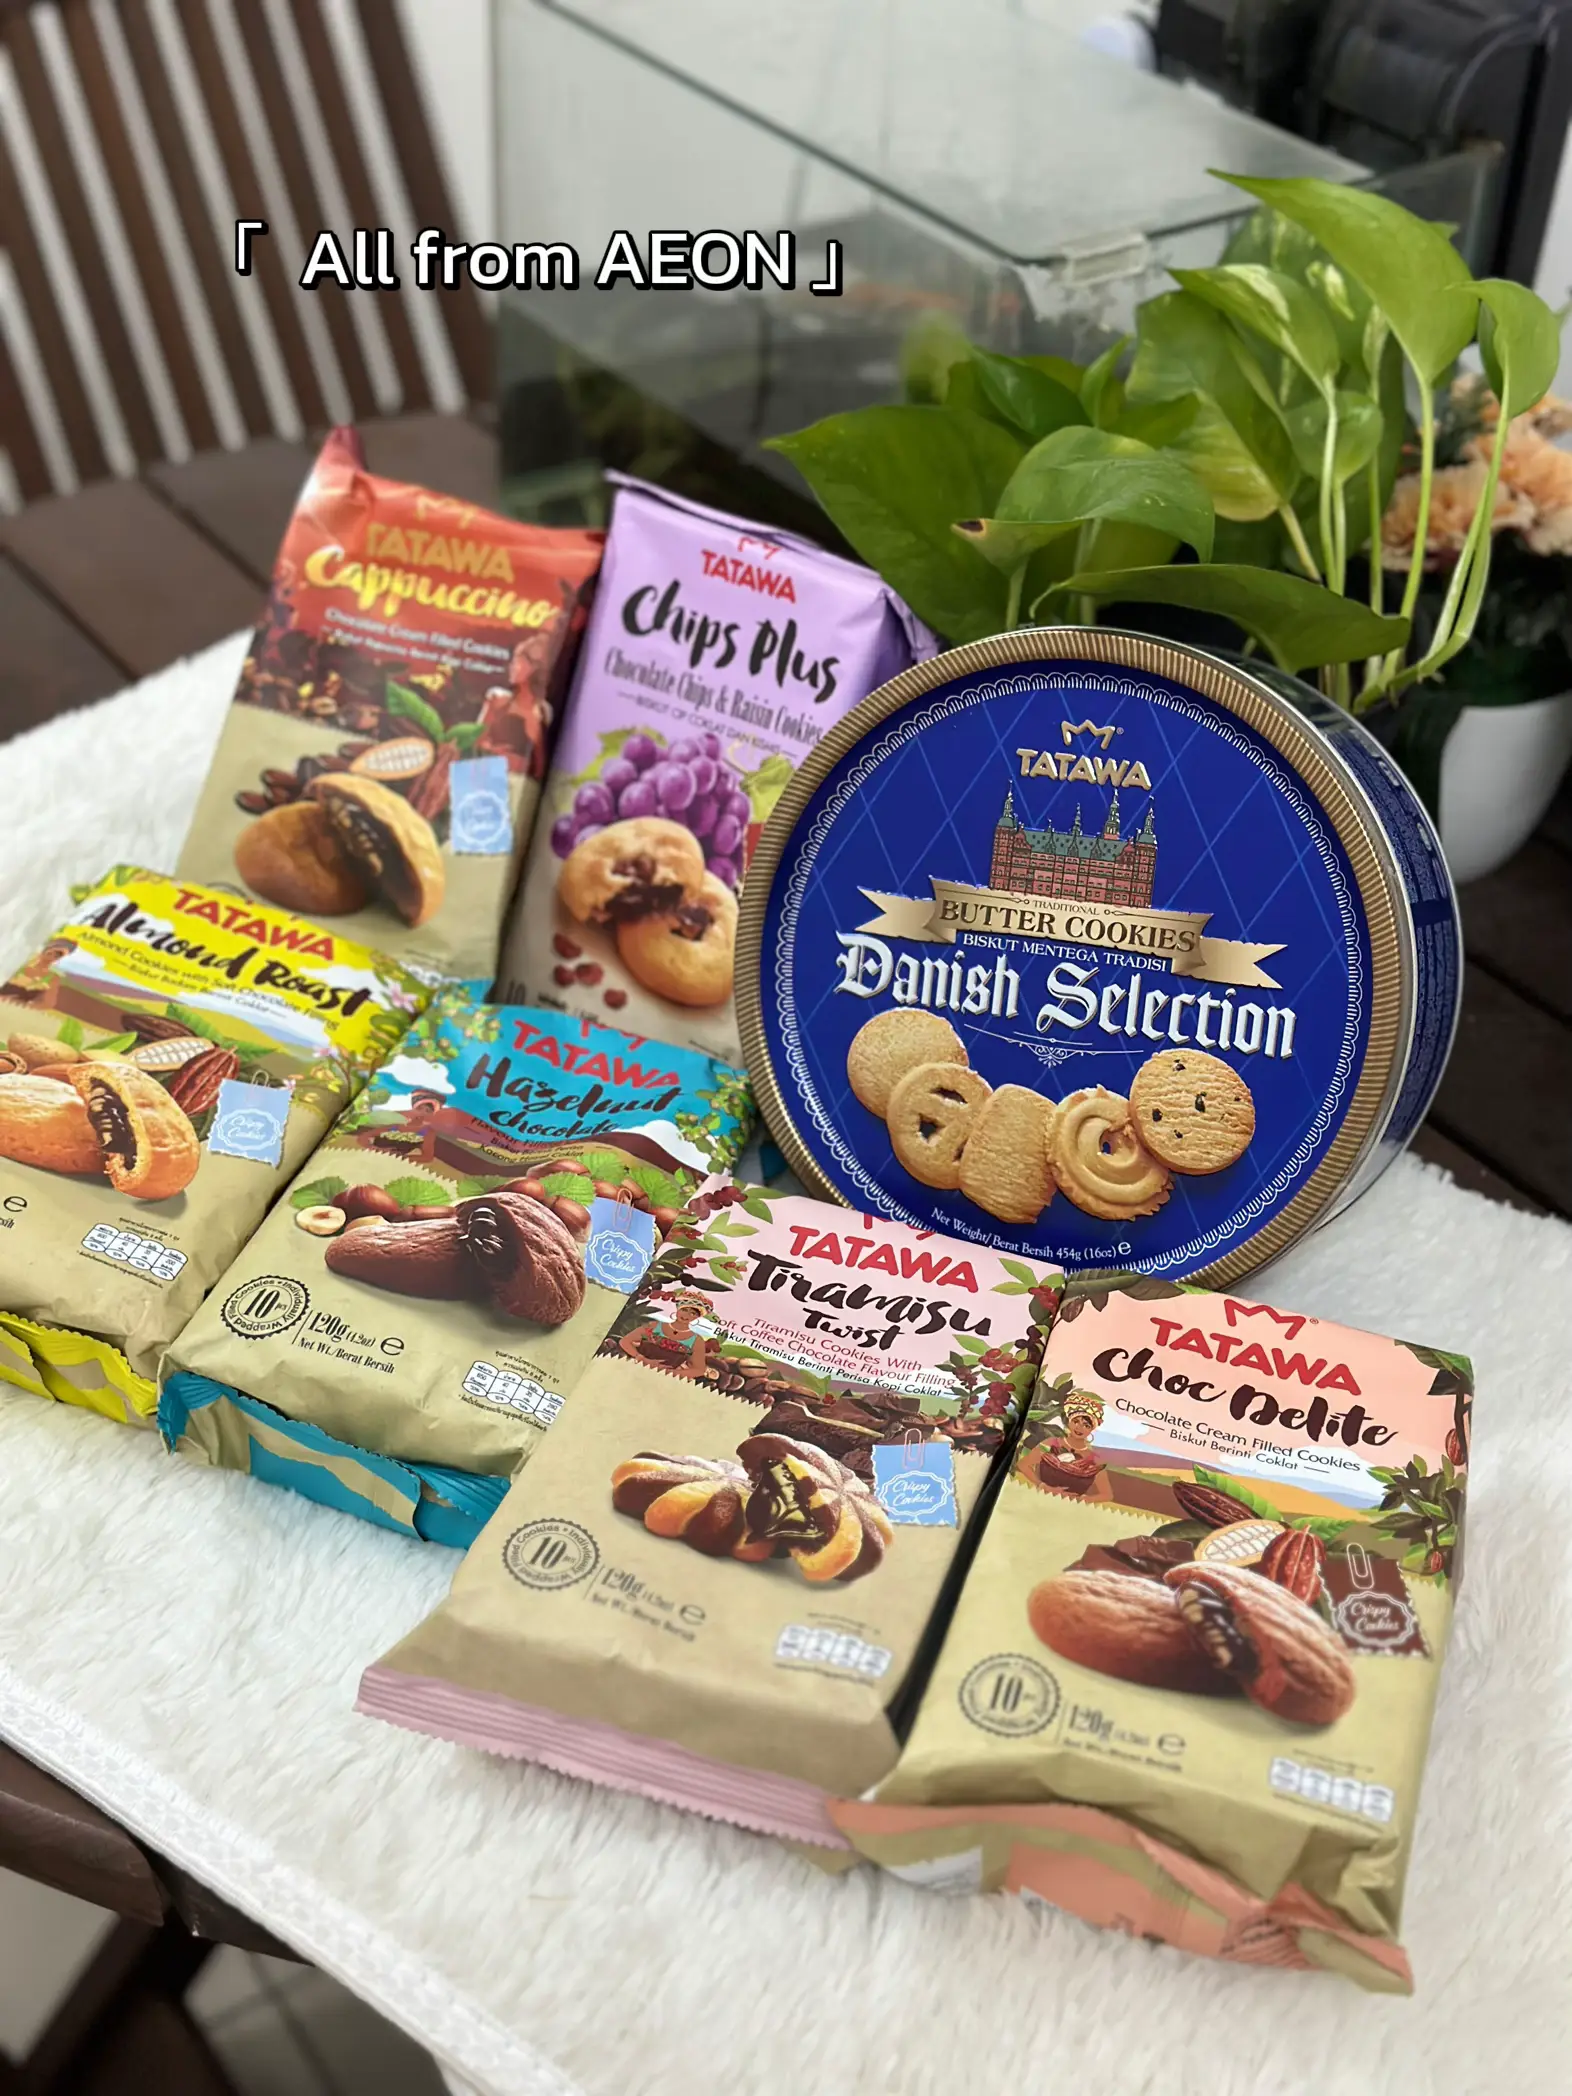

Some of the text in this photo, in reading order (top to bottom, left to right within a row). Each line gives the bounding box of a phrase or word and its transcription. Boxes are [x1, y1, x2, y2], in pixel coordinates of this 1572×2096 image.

[367, 523, 514, 583] TATAWA
[701, 549, 796, 603] TATAWA
[305, 545, 559, 627] Cappuccino
[622, 579, 840, 704] Chips Plus
[604, 647, 823, 748] Chocolate Chips & Raisin Cookies
[1016, 748, 1152, 791] TATAWA
[174, 889, 335, 962] TATAWA
[939, 898, 1197, 954] BUTTER COOKIES
[1033, 900, 1100, 916] TRADITIONAL
[78, 931, 129, 957] Almond
[79, 901, 374, 1018] Almond Roast
[963, 933, 1167, 973] BISKUT MENTEGA TRADISI
[833, 930, 1020, 1019] Danish
[1036, 961, 1298, 1059] Selection
[513, 1020, 681, 1089] TATAWA
[466, 1053, 682, 1118] Hazelnut
[601, 1239, 634, 1260] Crispy
[790, 1225, 979, 1294] TATAWA
[931, 1207, 950, 1227] Net
[992, 1235, 1019, 1252] Berat
[1022, 1242, 1053, 1258] Bersih
[1056, 1247, 1082, 1261] 454g
[235, 1279, 275, 1299] Cookies
[600, 1253, 636, 1273] Cookies
[243, 1288, 280, 1318] 10
[748, 1249, 993, 1337] Tiramisu
[308, 1311, 350, 1342] 120g
[711, 1315, 956, 1389] Soft Coffee Chocolate Flavour Filling
[754, 1317, 922, 1371] Tiramisu Cookies With
[802, 1307, 905, 1351] Twist
[299, 1337, 316, 1351] Net
[364, 1355, 395, 1374] Bersih
[749, 1338, 795, 1361] Tiramisu
[797, 1356, 835, 1374] Berinti
[836, 1368, 870, 1384] Perisa
[873, 1379, 901, 1392] Kopi
[904, 1384, 941, 1397] Coklat
[1150, 1317, 1362, 1396] TATAWA
[1092, 1347, 1399, 1447] Choc Delite
[1115, 1398, 1361, 1472] Chocolate Cream Filled Cookies
[1169, 1429, 1298, 1470] Biskut Berinti Coklat
[528, 1536, 567, 1569] 10
[601, 1568, 646, 1602] 120g
[990, 1673, 1023, 1713] 10
